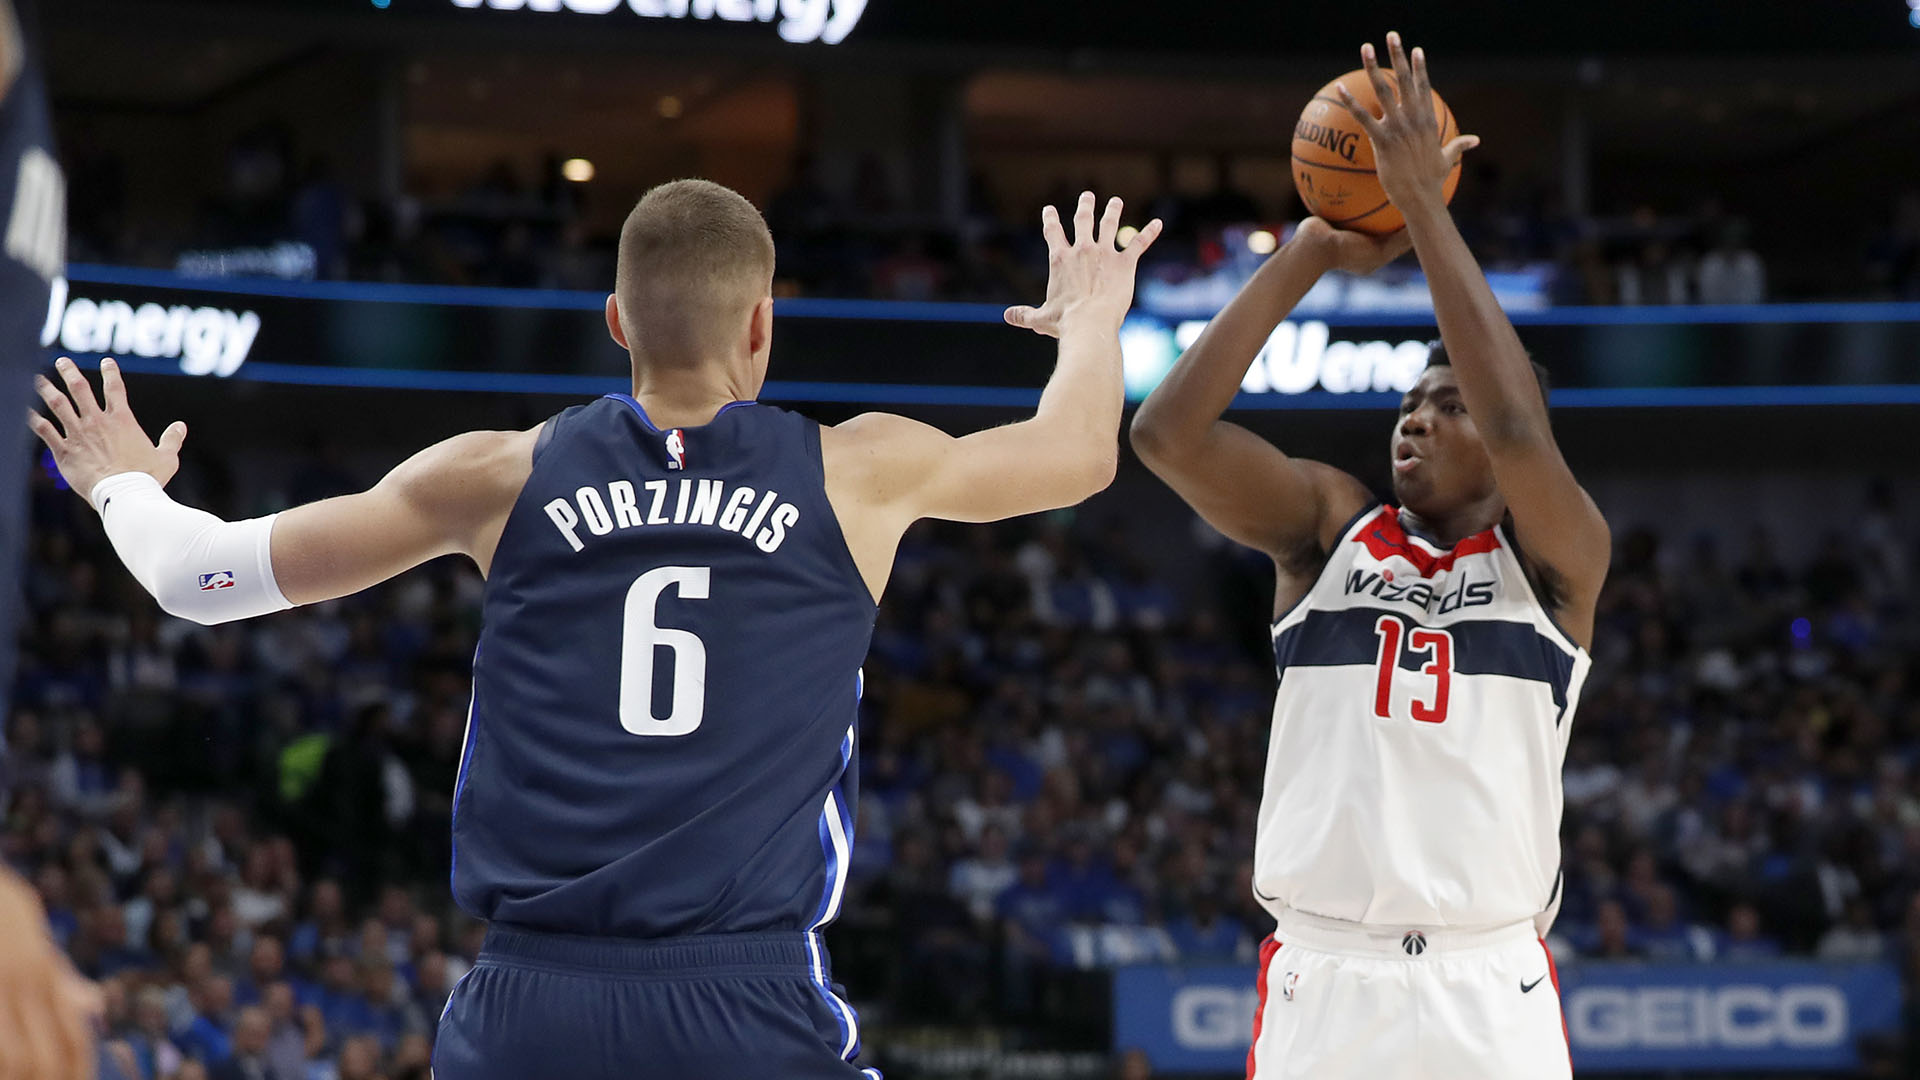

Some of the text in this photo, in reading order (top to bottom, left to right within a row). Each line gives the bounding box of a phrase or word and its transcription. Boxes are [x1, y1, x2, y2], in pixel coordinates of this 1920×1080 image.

[544, 478, 799, 553] PORZINGIS
[619, 565, 711, 736] 6
[1374, 615, 1453, 725] 13
[1569, 985, 1846, 1048] GEICO
